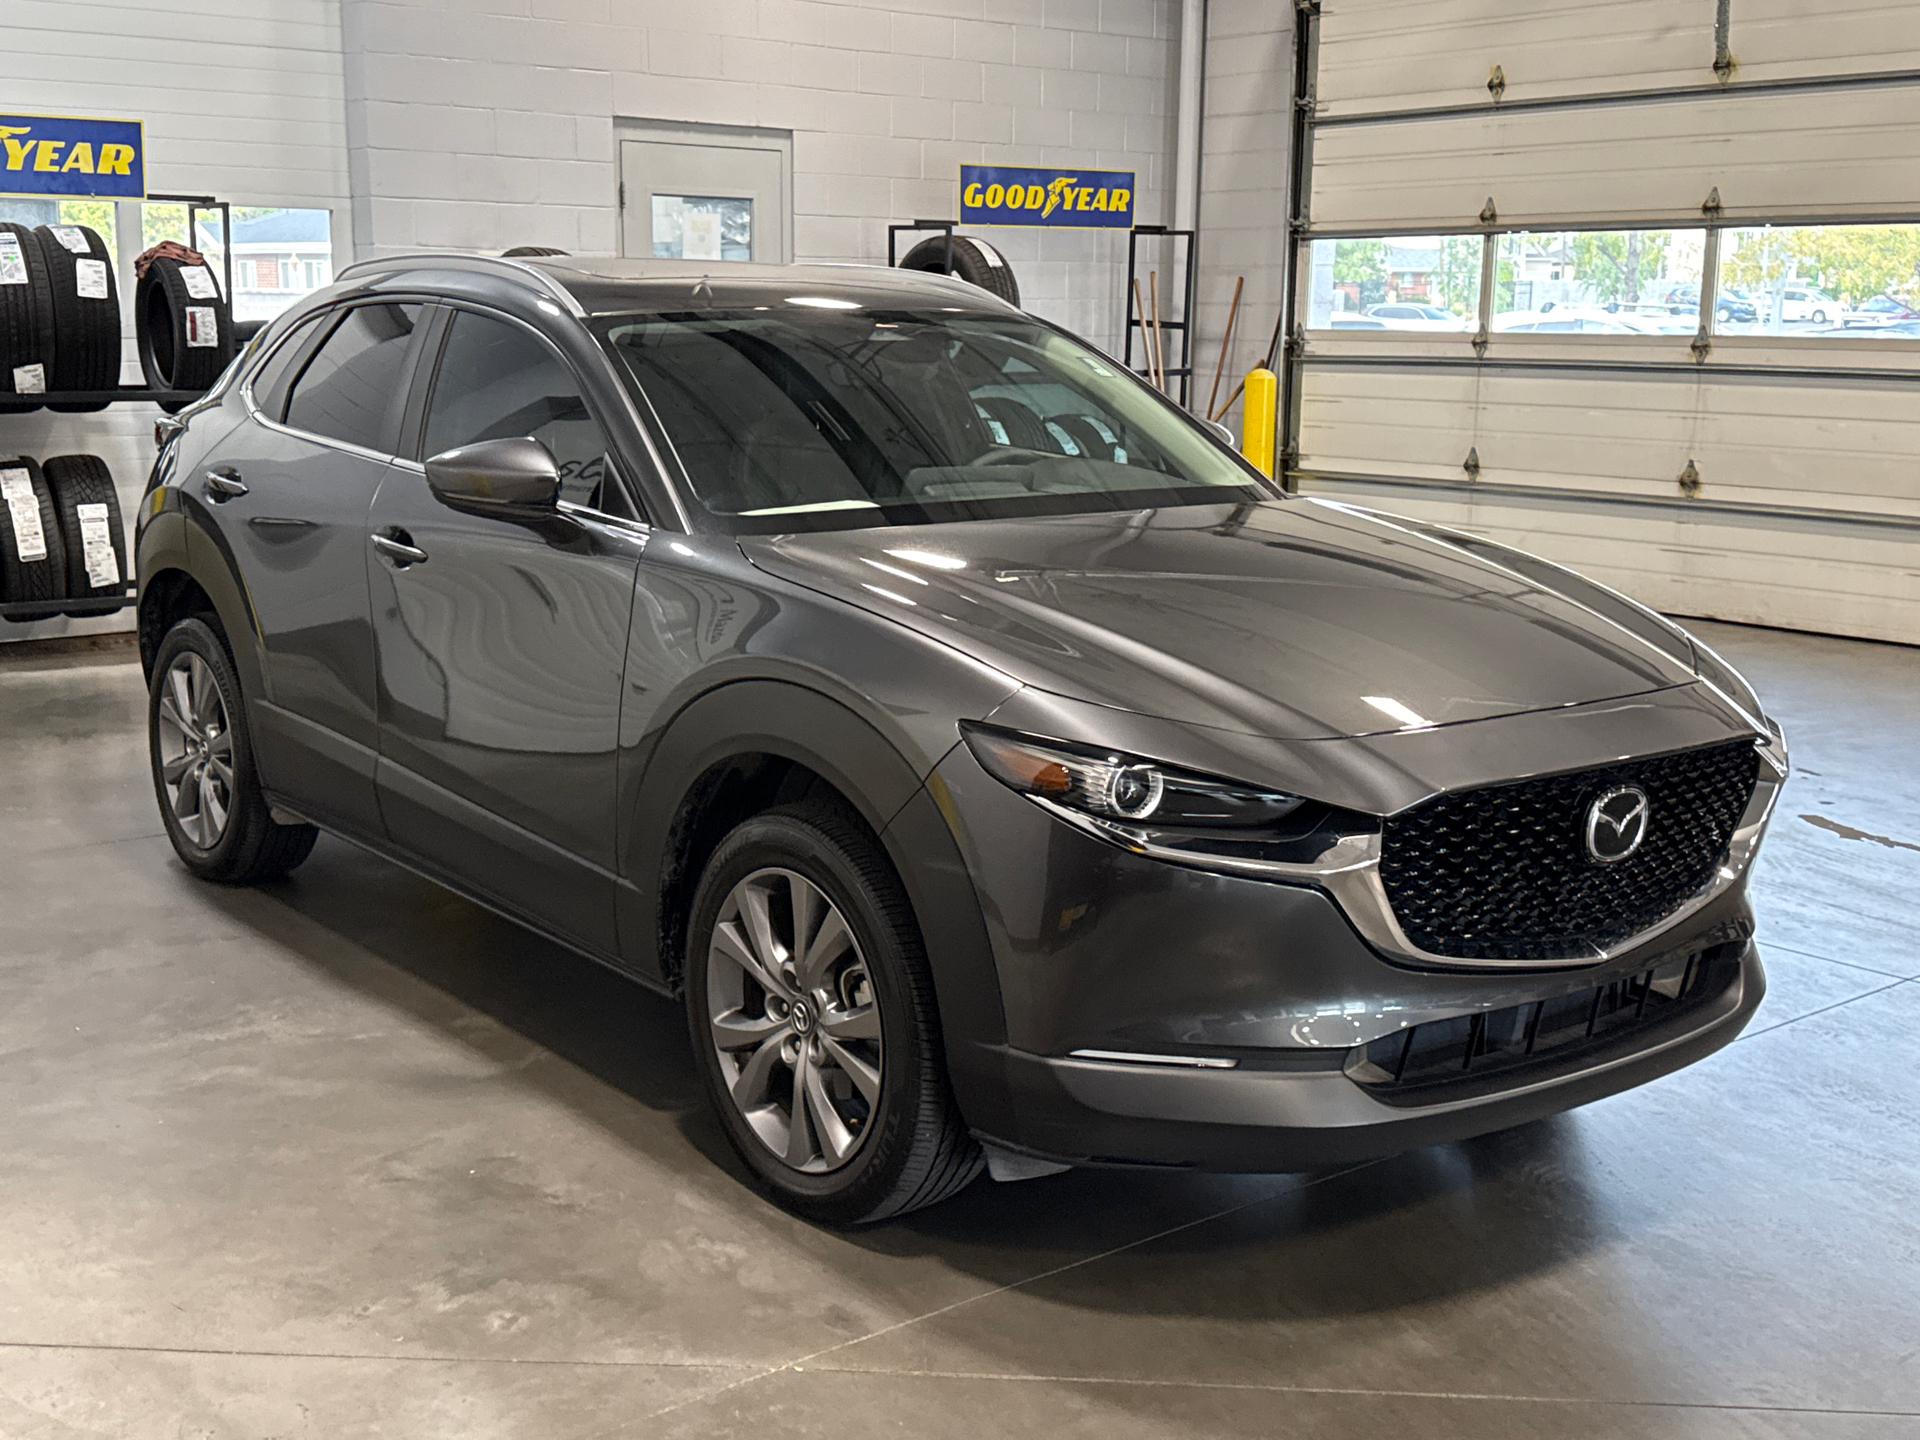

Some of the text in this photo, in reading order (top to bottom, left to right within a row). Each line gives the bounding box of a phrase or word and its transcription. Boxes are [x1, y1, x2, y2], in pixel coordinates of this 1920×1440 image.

[3, 139, 135, 175] YEAR
[964, 183, 1131, 212] GOOD YEAR
